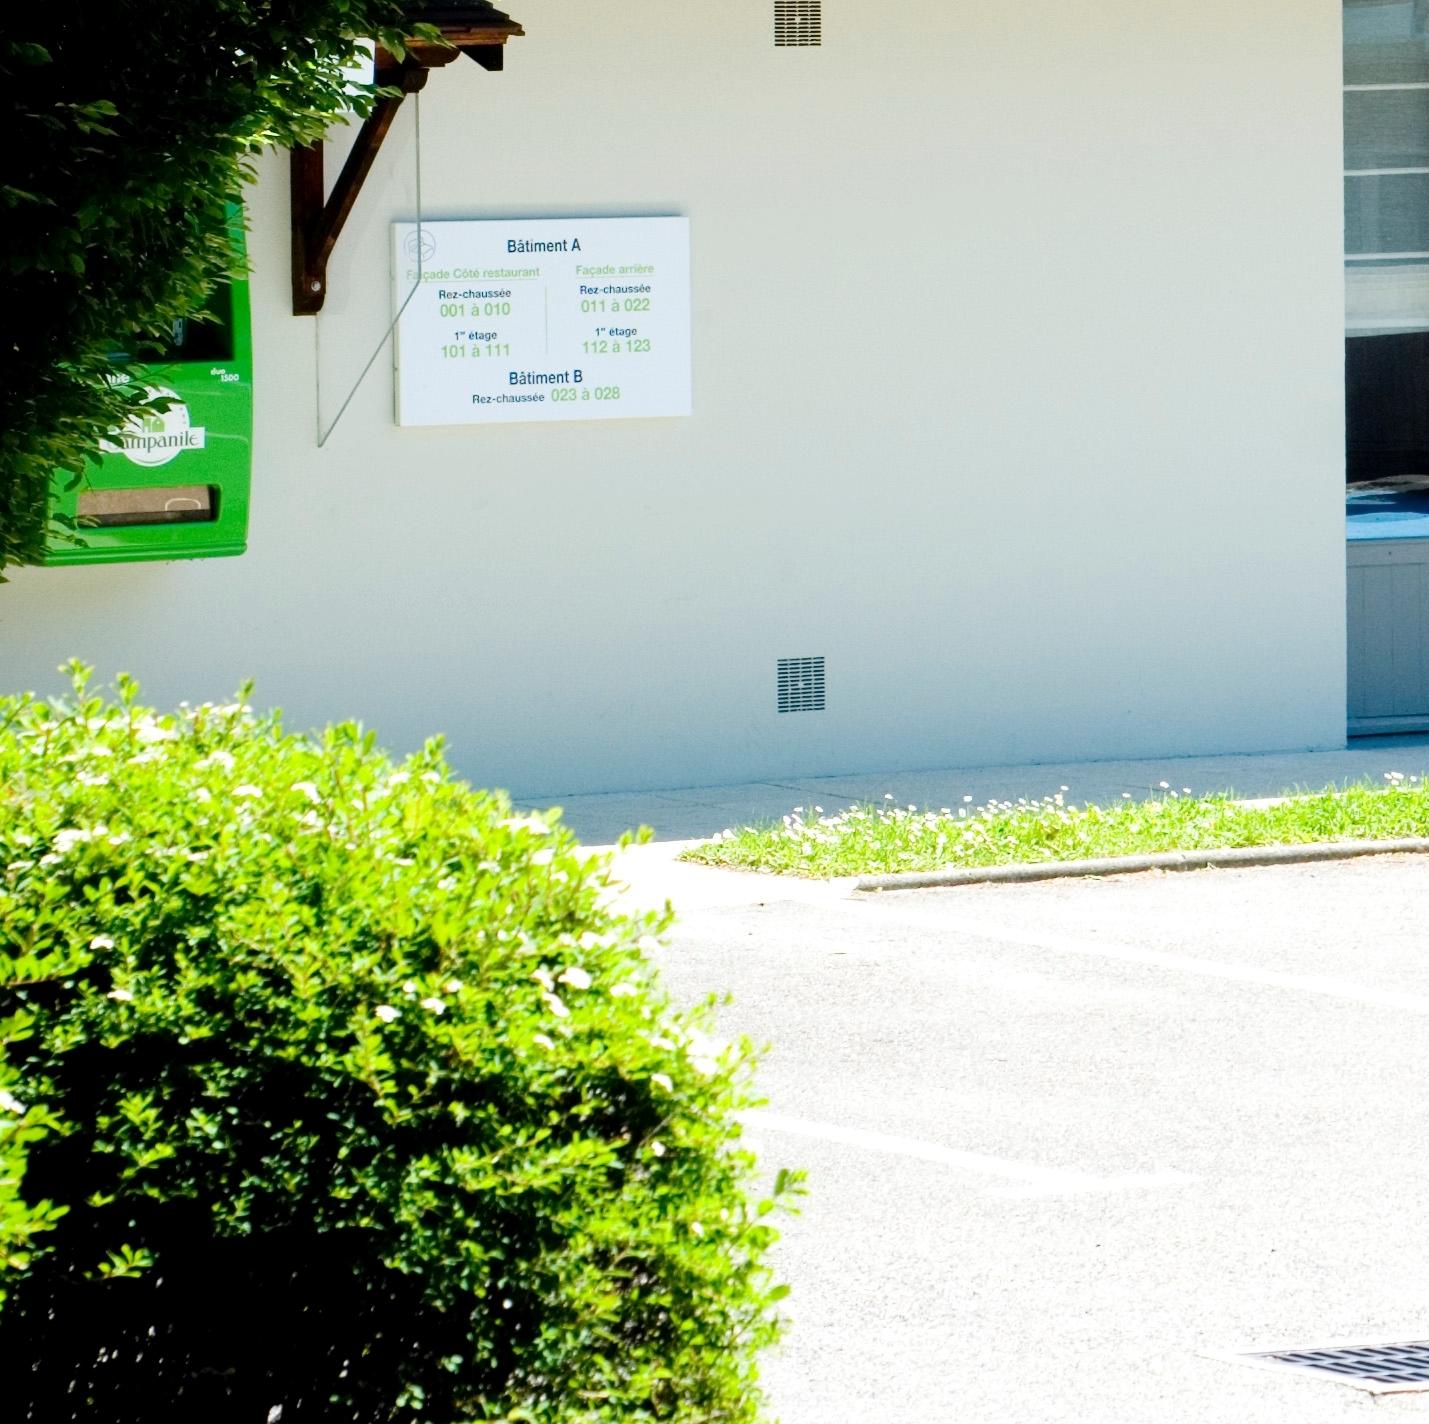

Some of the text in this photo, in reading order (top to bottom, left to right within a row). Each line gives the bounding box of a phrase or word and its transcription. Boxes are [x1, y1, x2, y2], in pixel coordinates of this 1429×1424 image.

[507, 238, 581, 253] Bâtiment A
[406, 269, 450, 282] Façade
[482, 267, 540, 278] restaurant
[575, 264, 655, 277] Façade arrière
[438, 289, 512, 300] Rez-chaussée
[579, 284, 651, 295] Rez-chaussée
[440, 302, 511, 317] 001 à 010
[580, 298, 650, 313] 011 à 022
[468, 330, 498, 342] étage
[608, 327, 638, 338] étage
[441, 344, 511, 358] 101 à 111
[582, 339, 652, 354] 112 à 123
[509, 369, 583, 385] Bâtiment B
[472, 387, 621, 404] Rez-chaussée 023 à 028
